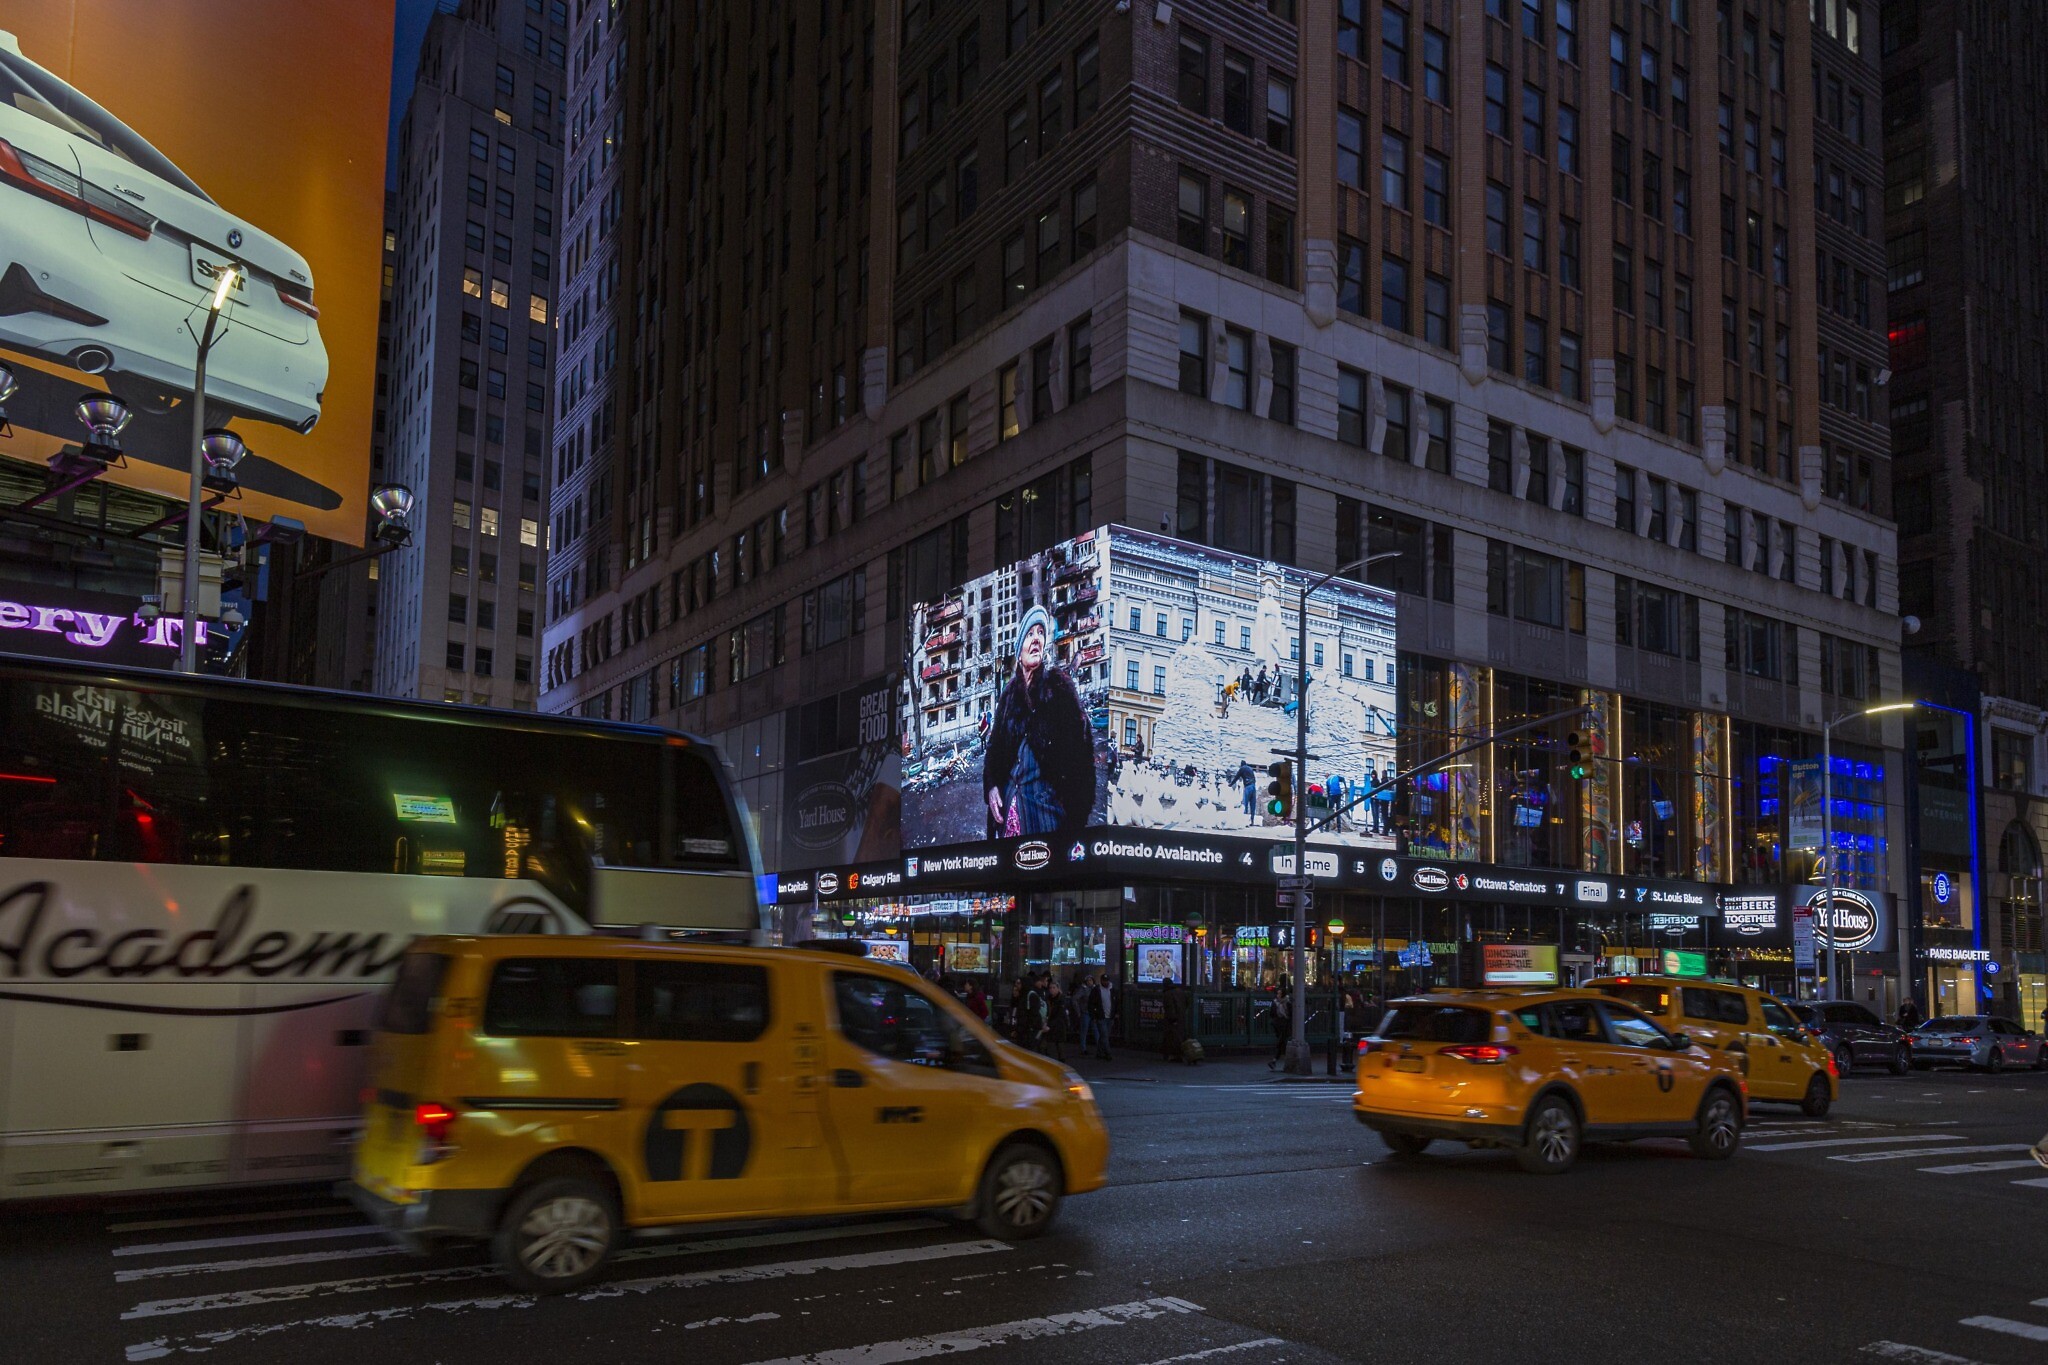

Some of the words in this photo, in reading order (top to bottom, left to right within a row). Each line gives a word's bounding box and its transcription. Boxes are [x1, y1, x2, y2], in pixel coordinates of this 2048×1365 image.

[0, 600, 127, 646] ery
[860, 689, 889, 719] GREAT
[859, 714, 888, 744] FOOD
[1792, 763, 1819, 771] Button
[799, 806, 818, 828] Yard
[819, 804, 847, 825] House
[1923, 808, 1963, 822] CATERING
[1020, 851, 1031, 860] Yard
[1031, 850, 1047, 860] House
[1094, 840, 1152, 858] Colorado
[1155, 845, 1223, 863] Avalanche
[1242, 852, 1252, 865] 4
[924, 860, 942, 873] New
[942, 858, 962, 870] York
[962, 855, 997, 870] Rangers
[1282, 856, 1292, 868] In
[1303, 860, 1331, 871] ame
[1356, 861, 1364, 873] 5
[862, 873, 886, 887] Calgary
[1418, 874, 1430, 884] Yard
[1430, 876, 1446, 885] House
[1475, 877, 1507, 891] Ottawa
[1509, 880, 1546, 894] Senators
[1558, 884, 1565, 895] 7
[787, 880, 808, 894] Capitals
[1583, 886, 1603, 897] Final
[1619, 888, 1626, 899] 2
[1652, 891, 1663, 902] St.
[1663, 892, 1682, 903] Louis
[1683, 894, 1703, 904] Blues
[1742, 901, 1775, 910] BEERS
[1724, 915, 1775, 923] TOGETHER
[1817, 908, 1839, 928] Yad
[1839, 909, 1868, 929] House
[0, 880, 410, 978] Academ
[1485, 949, 1528, 958] DINOSAUR
[1930, 948, 1953, 959] PARIS
[1953, 949, 1990, 961] BAGUETTE
[662, 1109, 737, 1180] T
